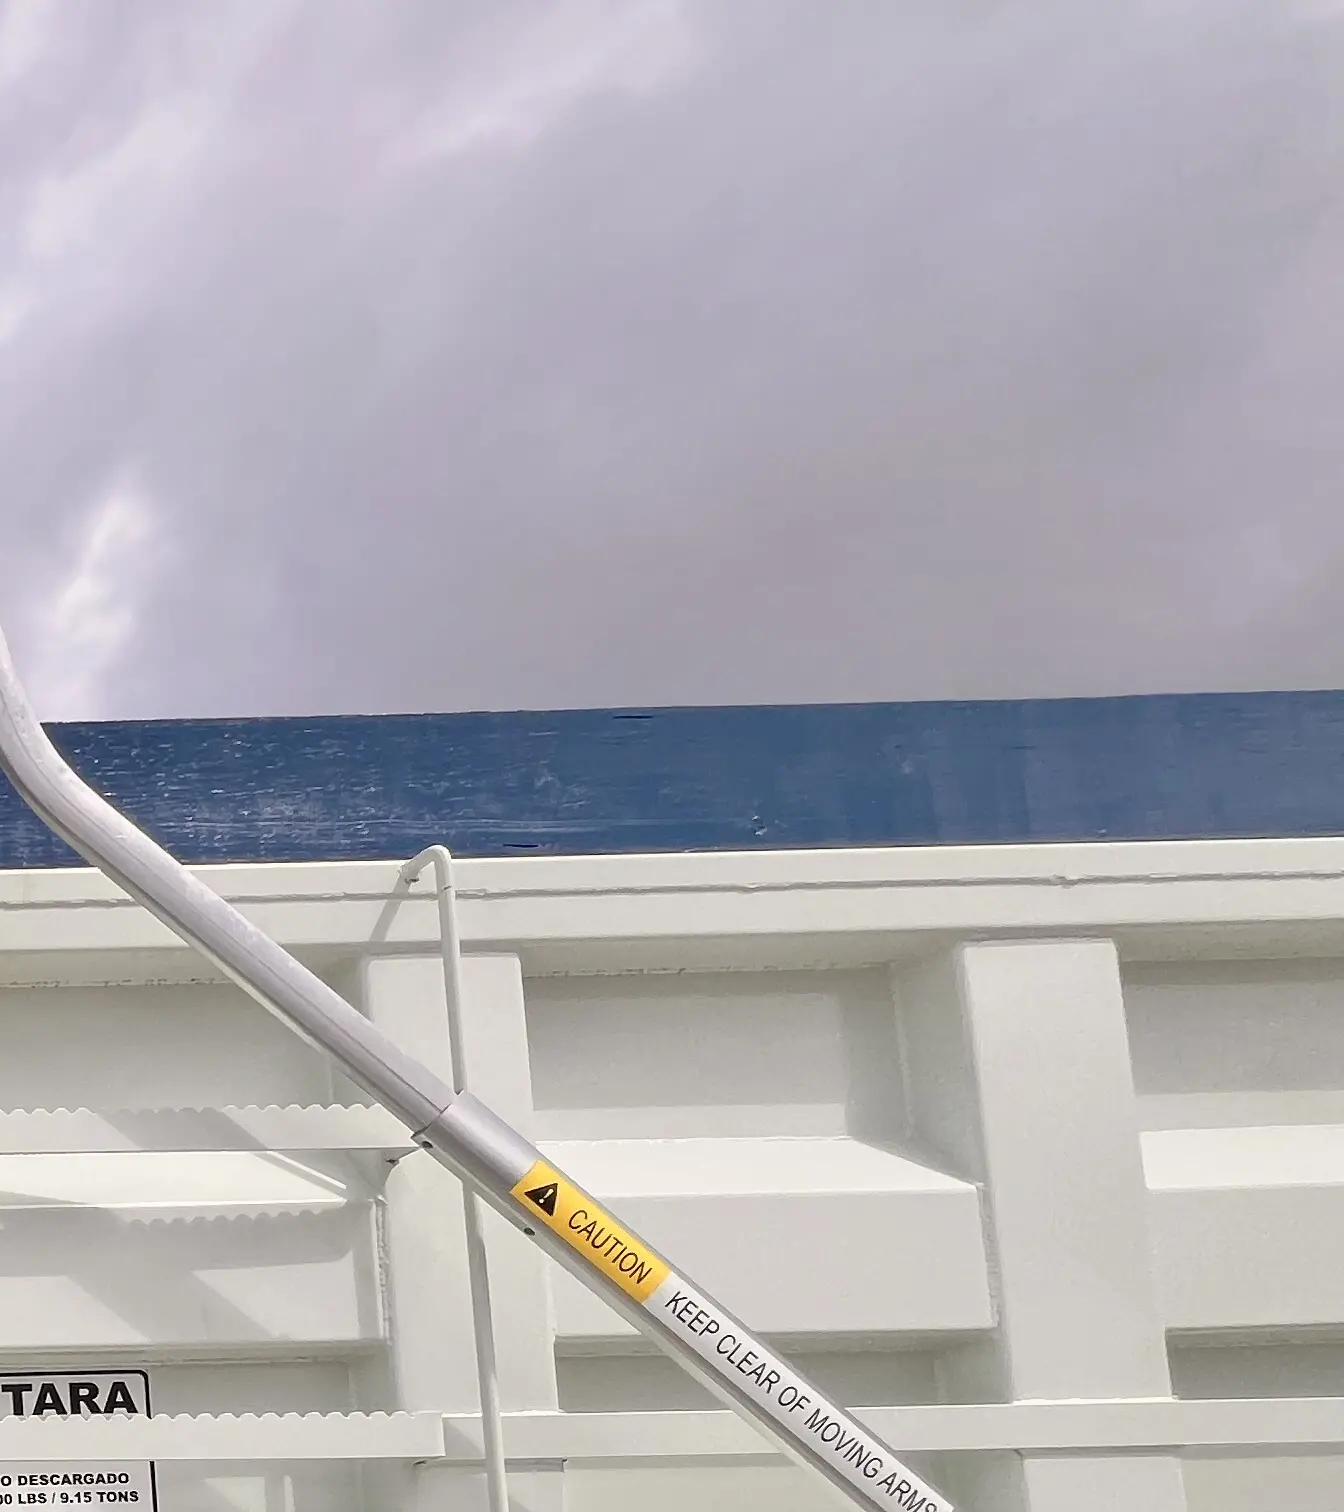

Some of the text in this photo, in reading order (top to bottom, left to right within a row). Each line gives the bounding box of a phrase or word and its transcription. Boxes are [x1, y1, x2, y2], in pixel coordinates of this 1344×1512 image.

[568, 1209, 653, 1284] CAUTION
[0, 1381, 139, 1416] TARA
[664, 1291, 720, 1336] KEEP
[716, 1334, 781, 1394] CLEAR
[777, 1386, 812, 1413] OF
[803, 1407, 884, 1479] MOVING
[17, 1472, 130, 1486] DESCARGADO
[18, 1493, 48, 1505] LBS
[51, 1491, 57, 1505] /
[60, 1491, 93, 1504] 9.15
[95, 1490, 140, 1503] TONS
